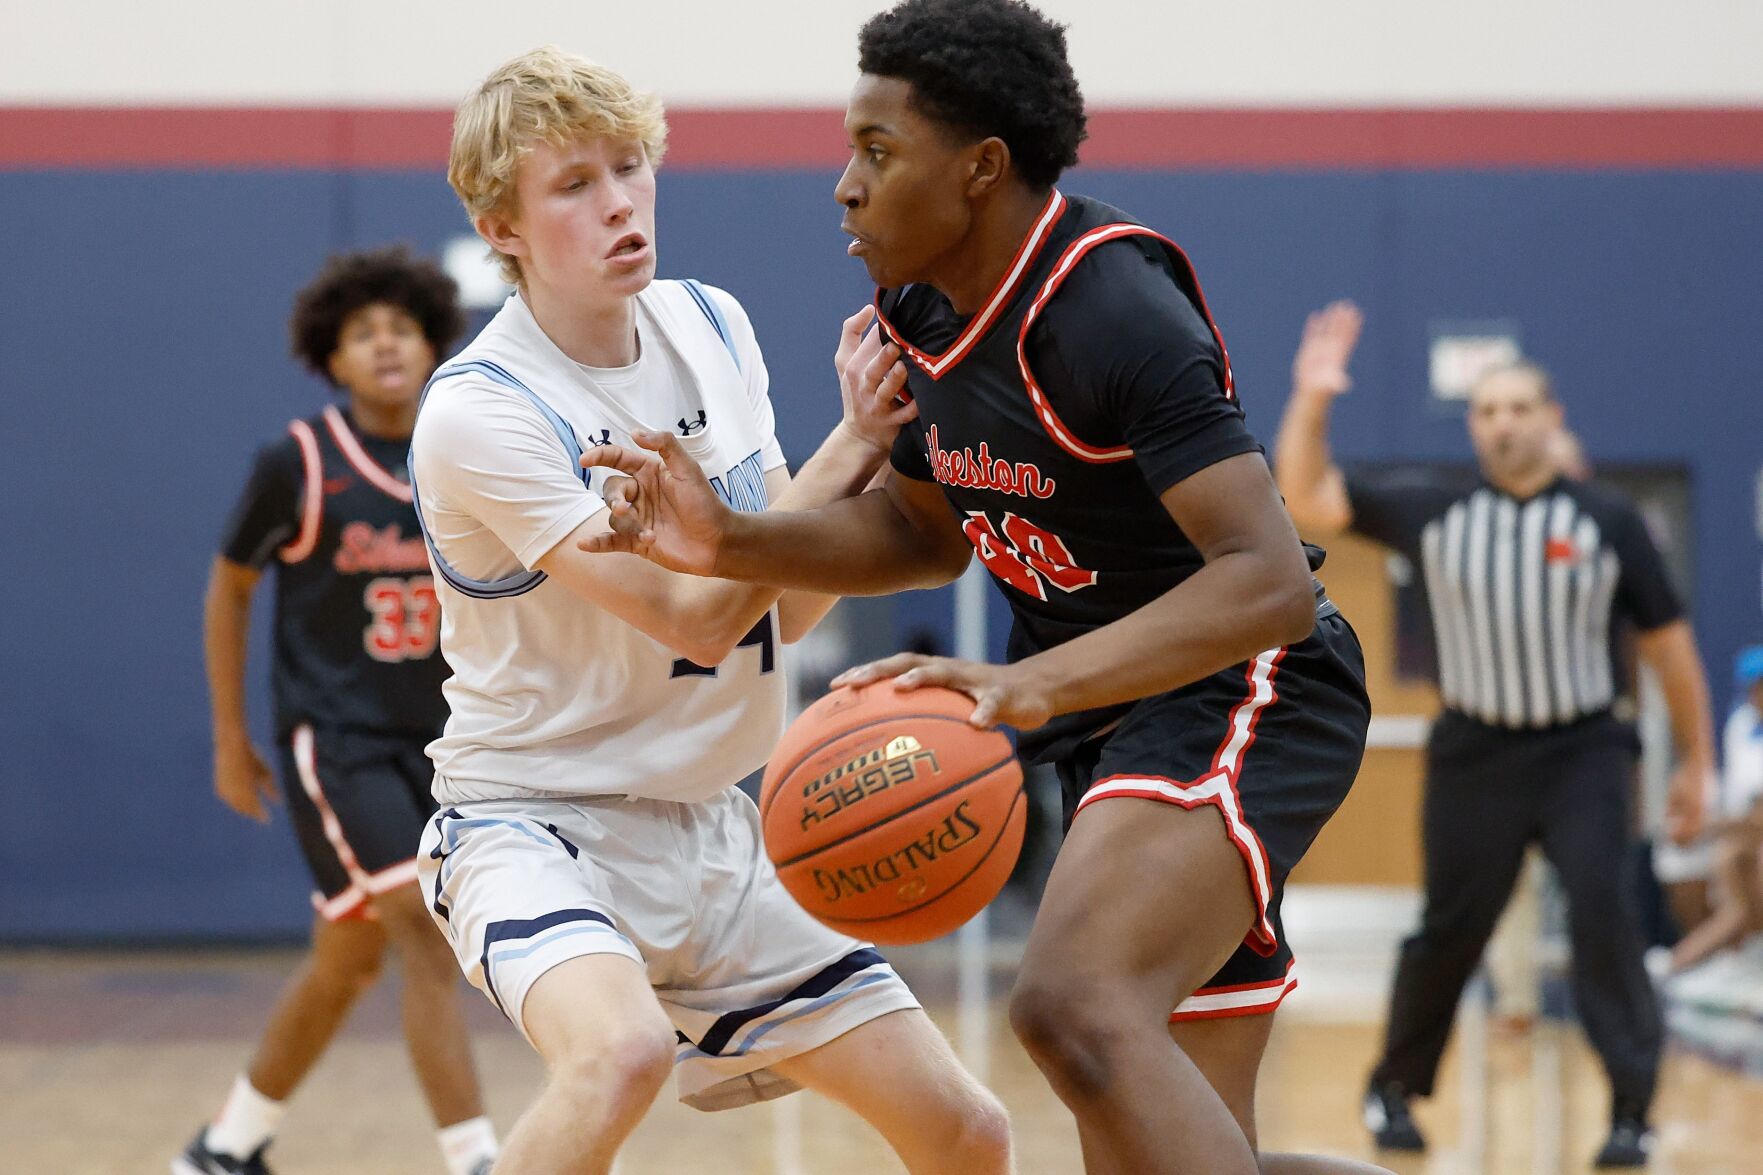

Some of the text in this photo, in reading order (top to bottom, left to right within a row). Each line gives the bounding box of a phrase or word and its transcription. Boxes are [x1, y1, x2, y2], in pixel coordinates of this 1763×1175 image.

[962, 511, 1098, 601] 40
[363, 575, 442, 662] 33
[801, 750, 942, 831] LEGACY
[812, 800, 981, 902] SPALDING
